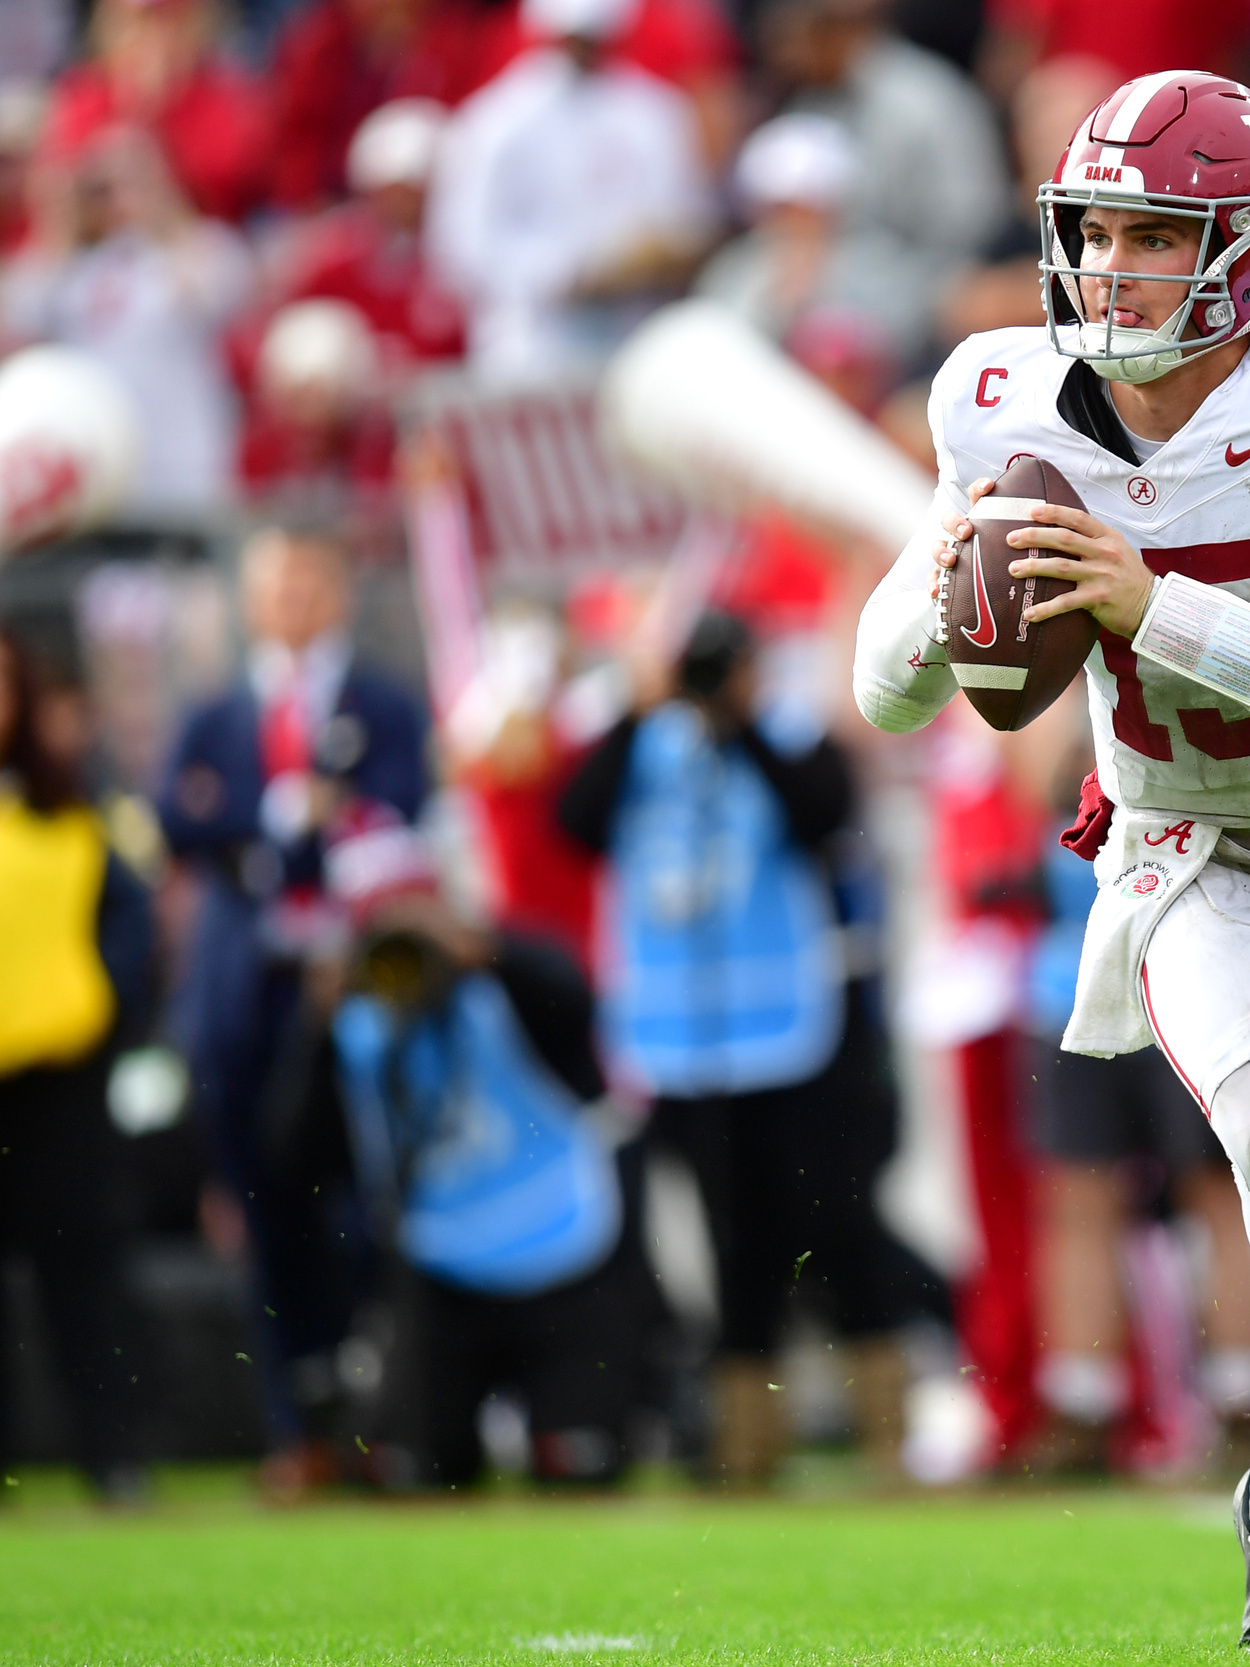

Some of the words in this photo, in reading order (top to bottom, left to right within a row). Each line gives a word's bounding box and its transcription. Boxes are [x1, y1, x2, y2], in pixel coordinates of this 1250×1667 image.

[1085, 165, 1123, 183] BAMA
[975, 367, 1009, 408] C
[1144, 820, 1196, 854] A
